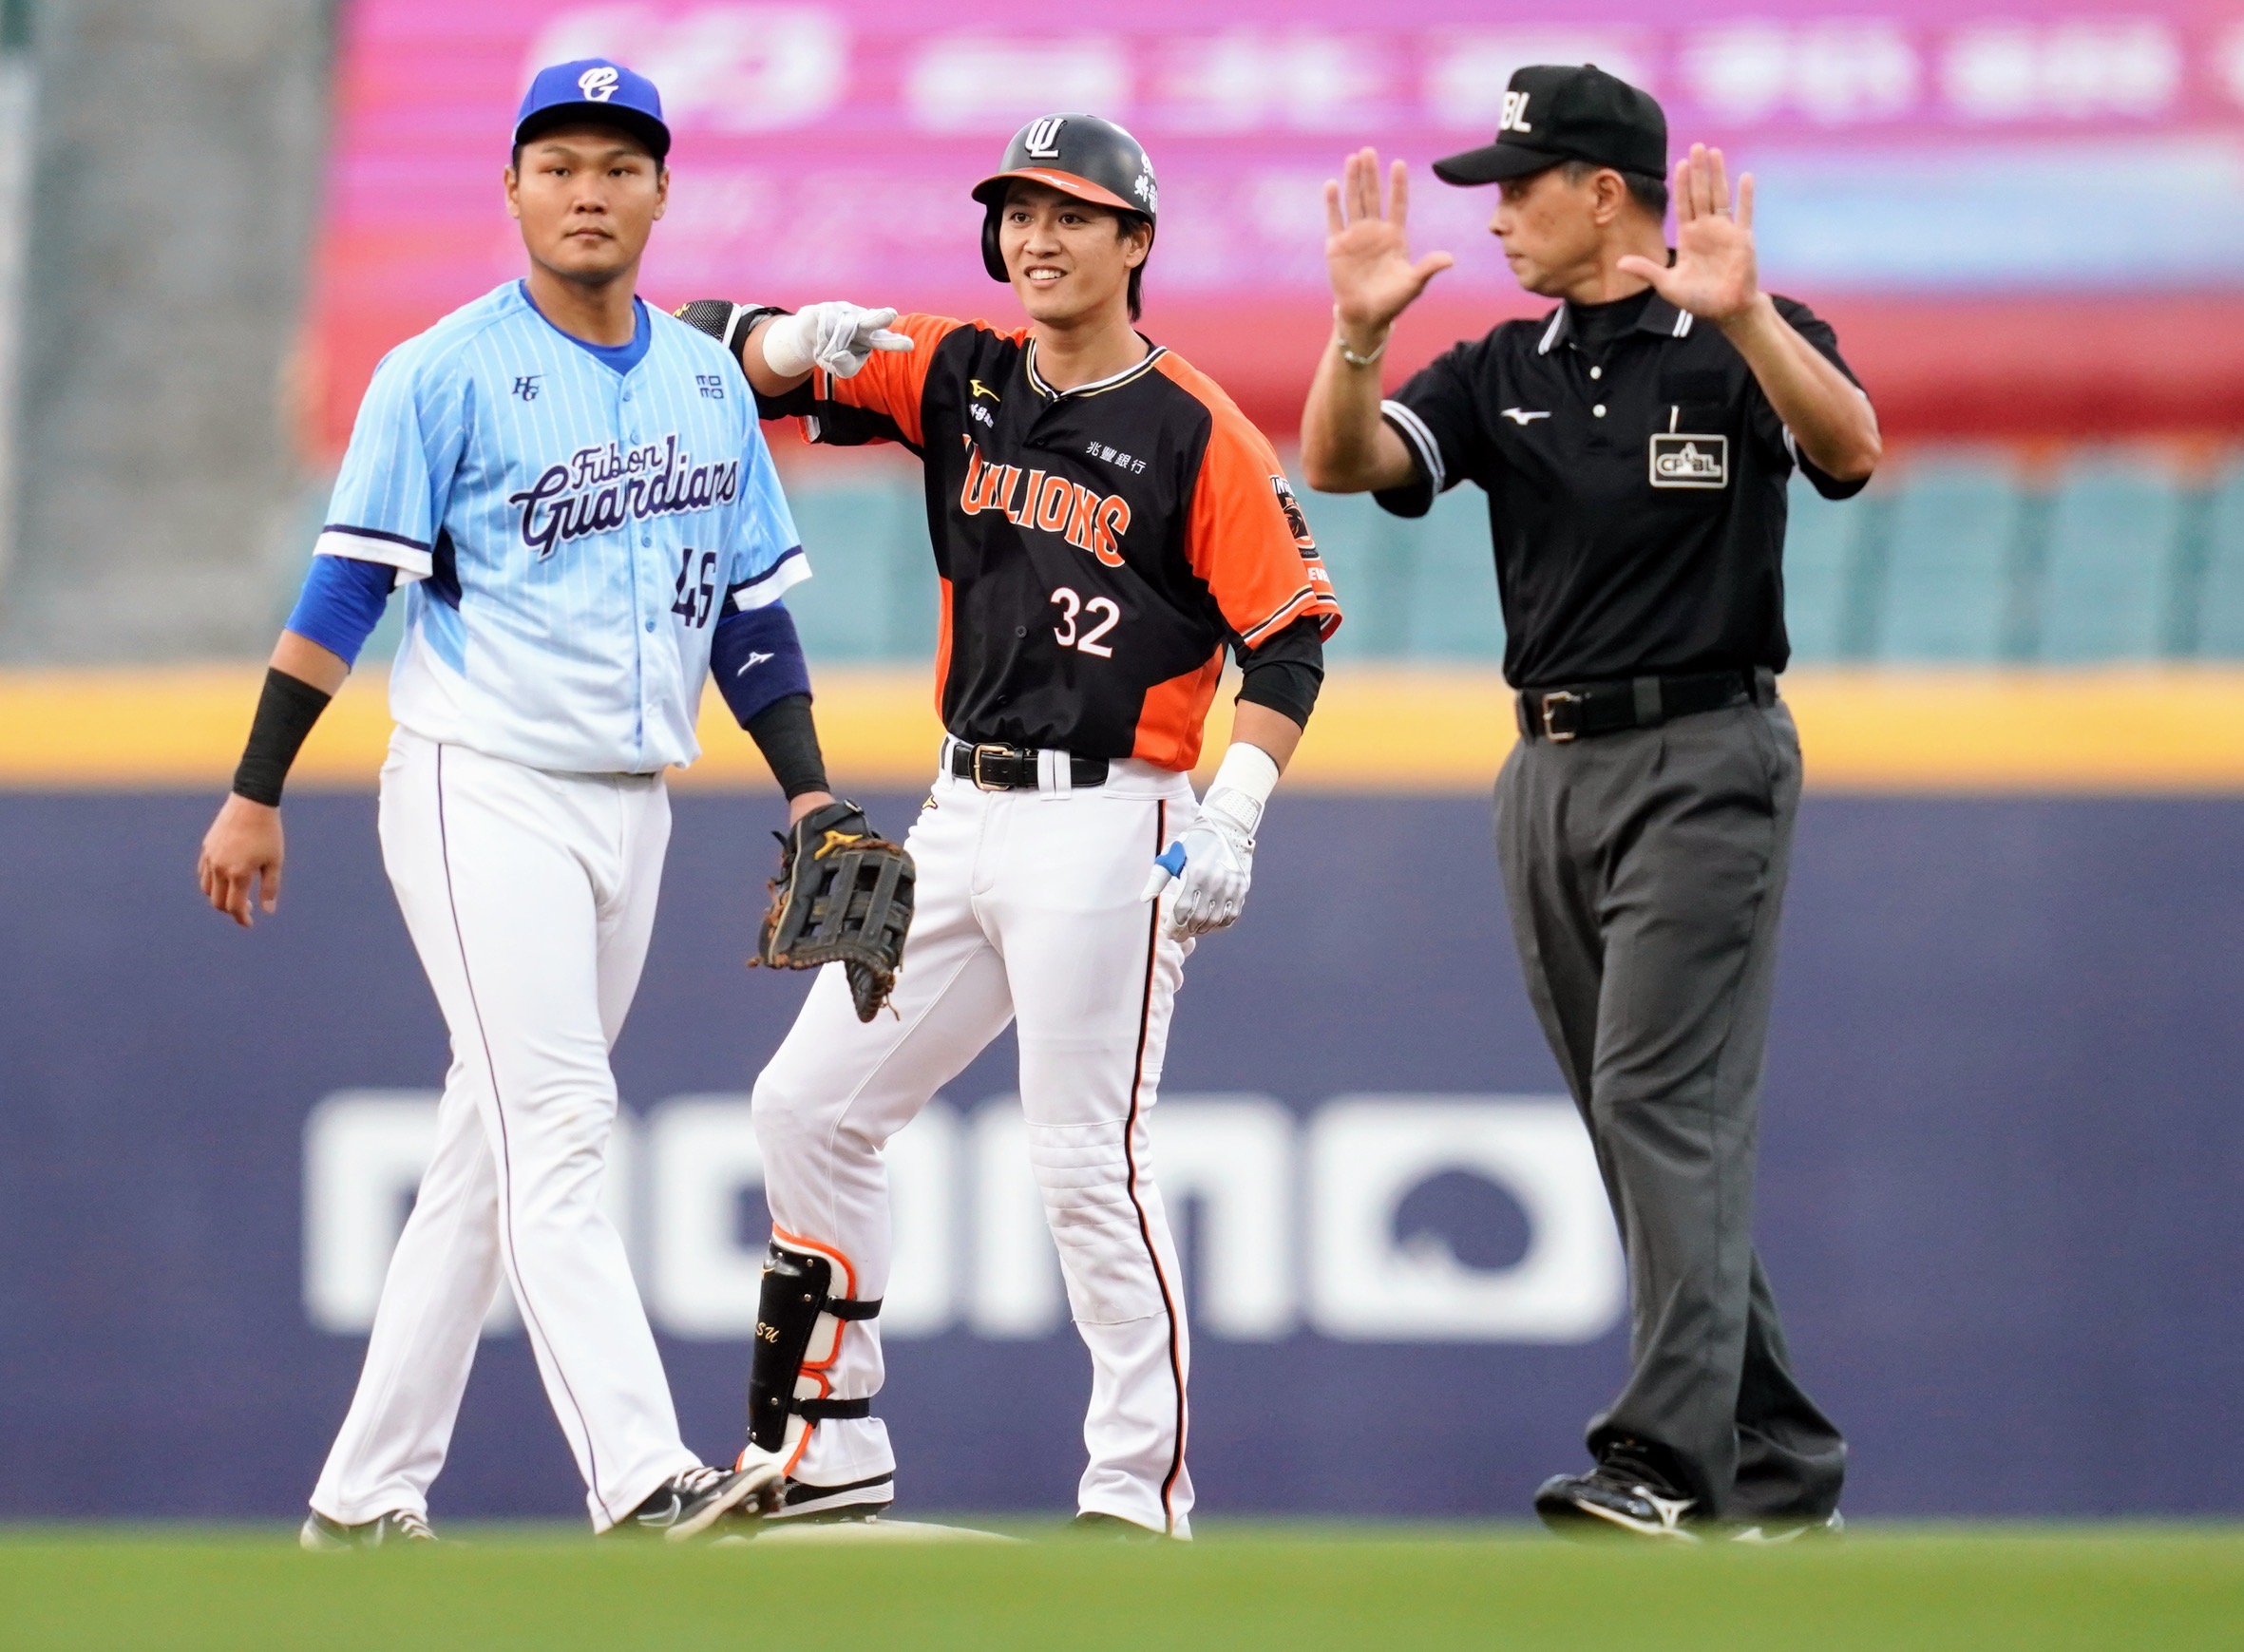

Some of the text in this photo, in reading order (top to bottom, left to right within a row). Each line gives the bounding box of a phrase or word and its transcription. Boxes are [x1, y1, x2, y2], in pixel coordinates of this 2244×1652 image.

[572, 442, 663, 489] Fubon
[1085, 441, 1147, 475] 兆豐銀行
[508, 432, 739, 562] Guardians
[1050, 587, 1120, 658] 32
